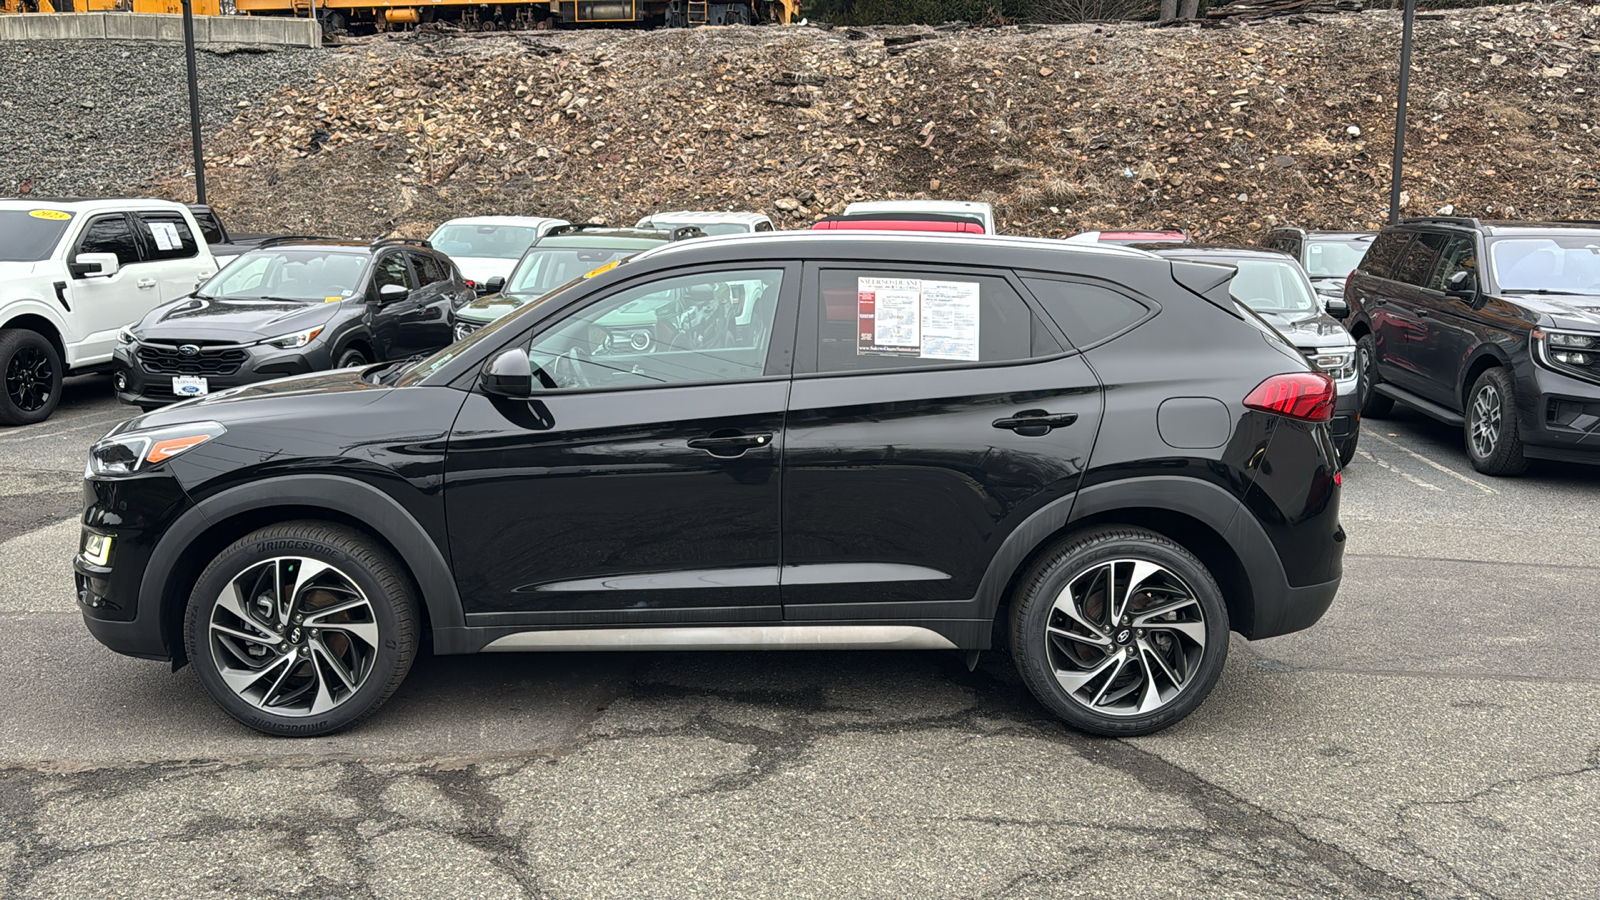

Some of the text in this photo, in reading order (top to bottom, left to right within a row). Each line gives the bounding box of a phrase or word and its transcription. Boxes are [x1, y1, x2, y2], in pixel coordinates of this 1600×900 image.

[35, 211, 66, 219] 2023
[257, 541, 339, 558] BRIDGESTONE
[190, 605, 199, 656] POTENZA
[250, 716, 328, 732] BRIDGESTONE
